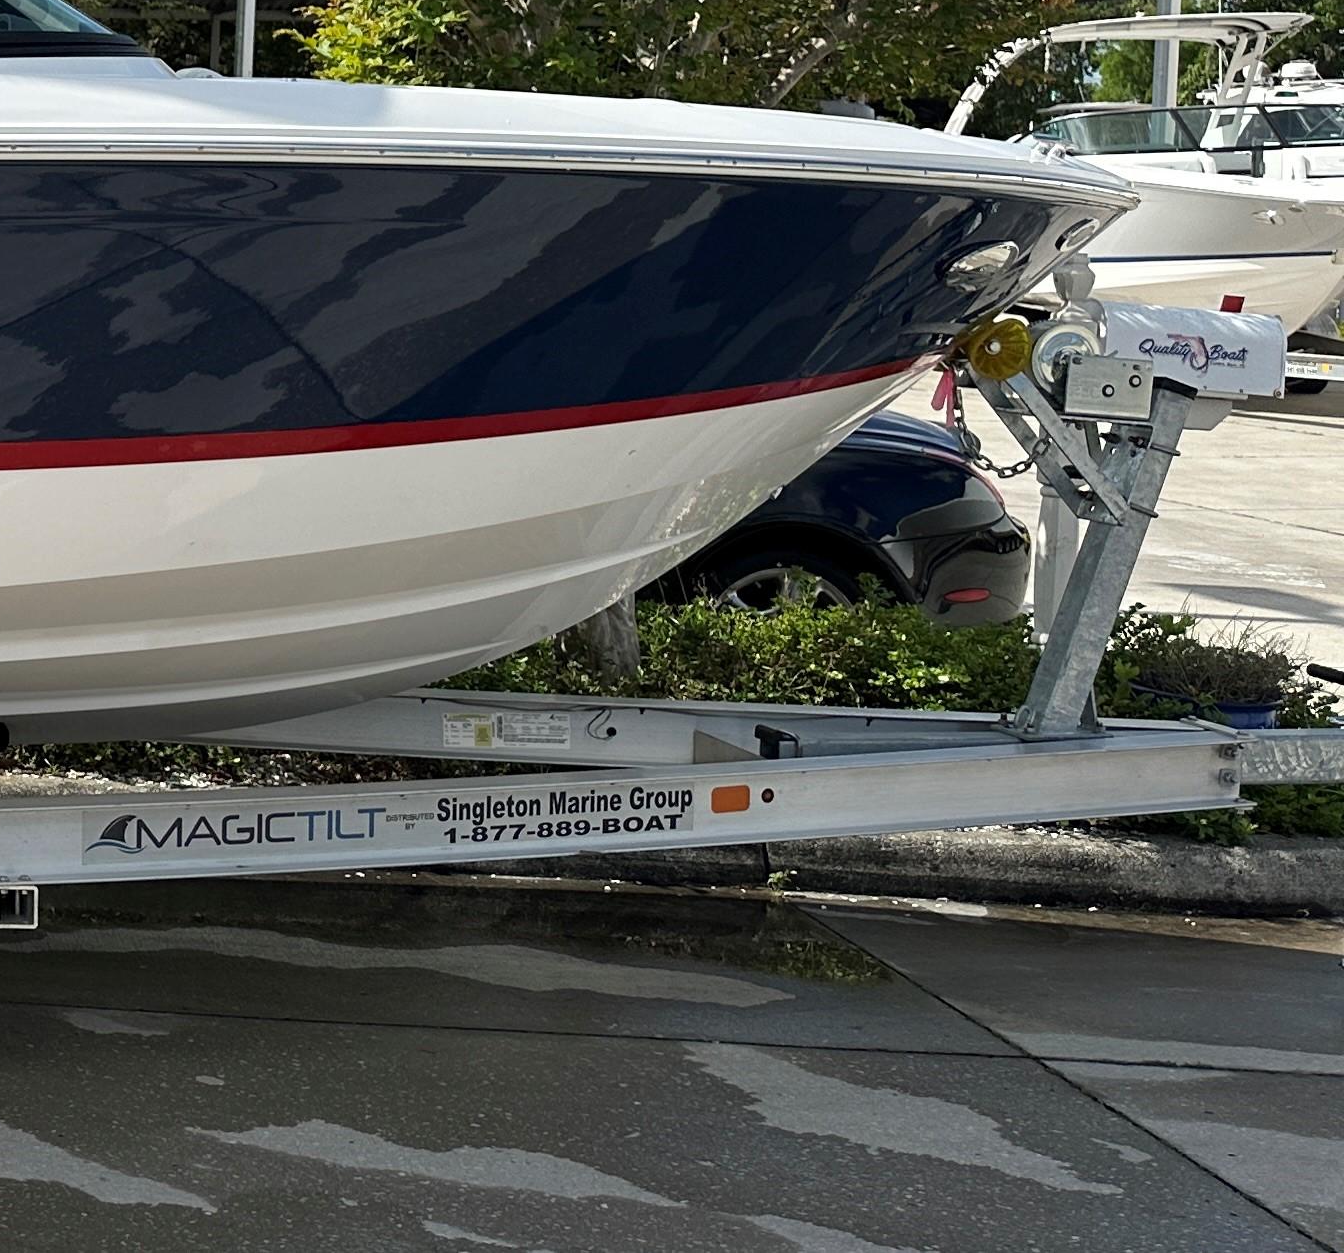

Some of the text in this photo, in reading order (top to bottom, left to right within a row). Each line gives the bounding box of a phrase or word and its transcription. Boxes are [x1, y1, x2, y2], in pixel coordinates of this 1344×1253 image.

[1138, 338, 1249, 364] Quality Boats
[385, 812, 435, 822] DISTRIBUTED
[436, 784, 694, 826] Singleton Marine Group
[443, 813, 684, 844] 1-877-889-BOAT
